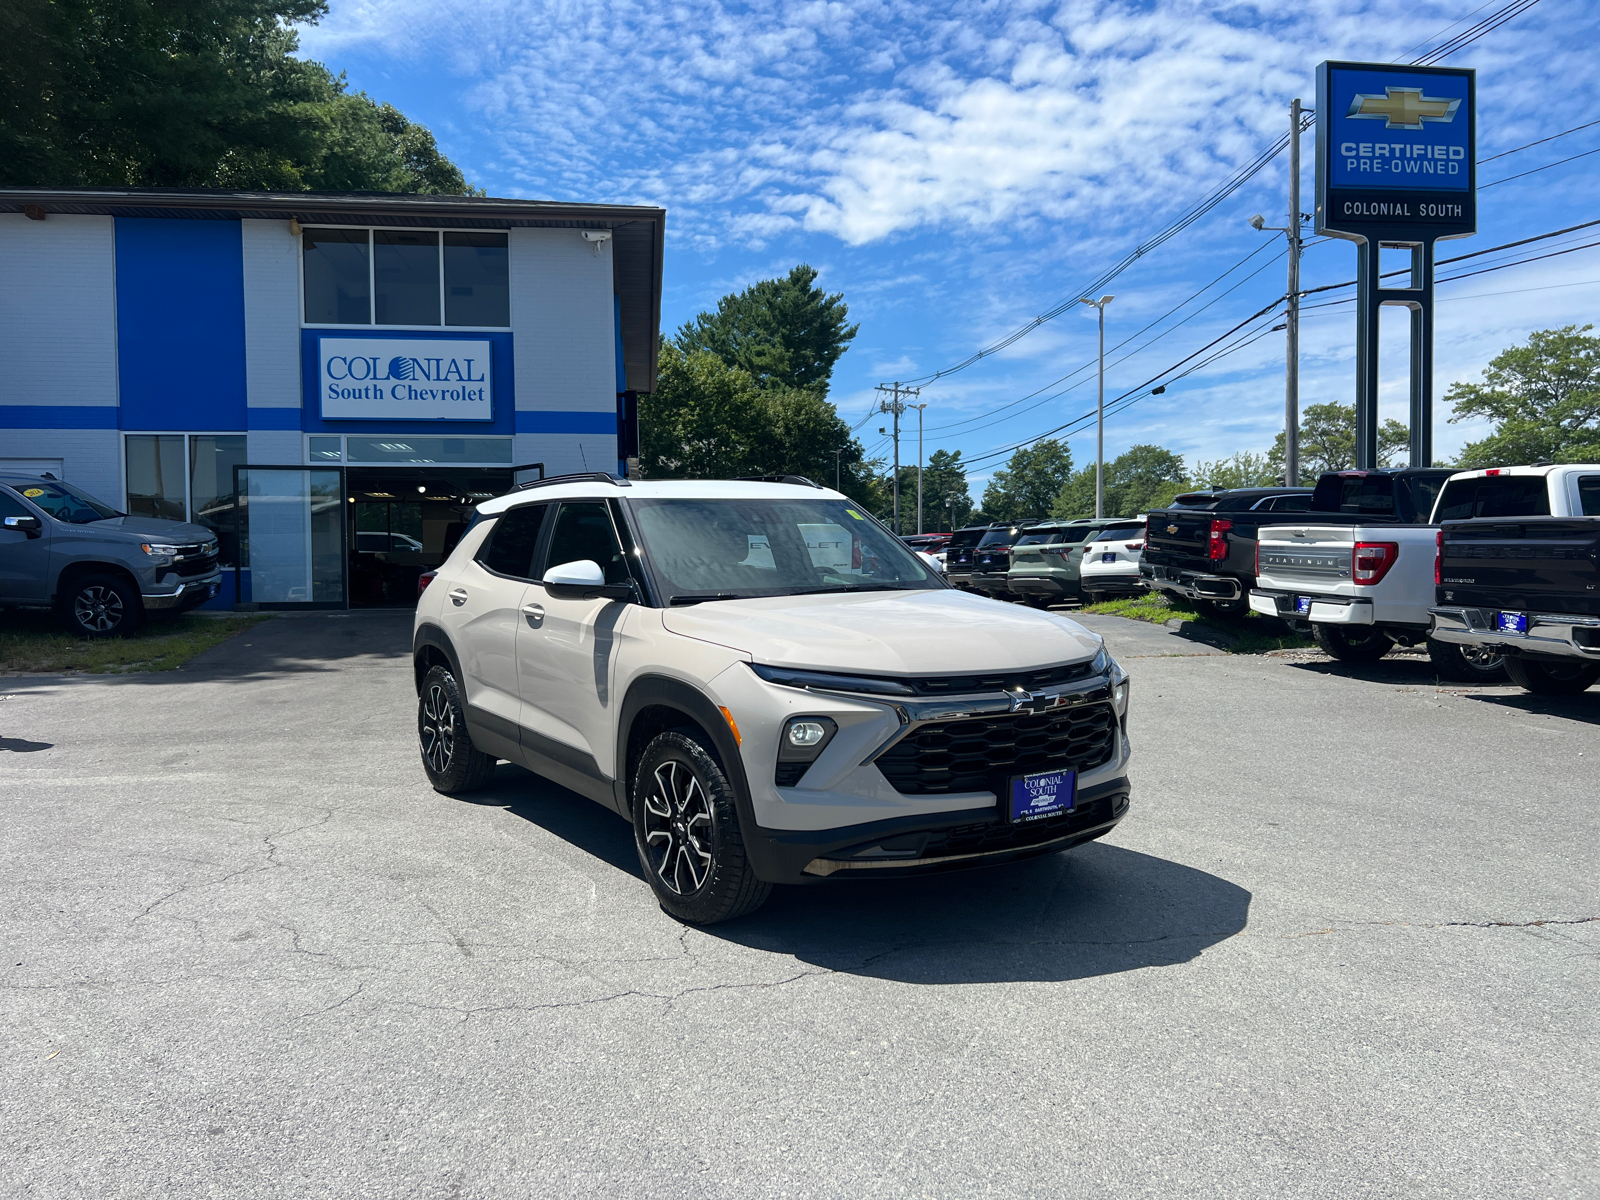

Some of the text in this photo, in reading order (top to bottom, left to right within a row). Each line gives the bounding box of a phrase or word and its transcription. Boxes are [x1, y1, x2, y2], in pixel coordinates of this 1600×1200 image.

[1341, 142, 1465, 160] CERTIFIED
[1347, 158, 1459, 175] PRE-OWNED
[1344, 201, 1462, 217] COLONIAL SOUTH
[326, 356, 485, 382] COLONIAL
[328, 382, 485, 401] South Chevrolet
[1269, 557, 1334, 566] PLATINUM
[1024, 775, 1063, 789] COLONIAL
[1030, 785, 1057, 797] SOUTH
[1026, 813, 1047, 822] COLONIAL
